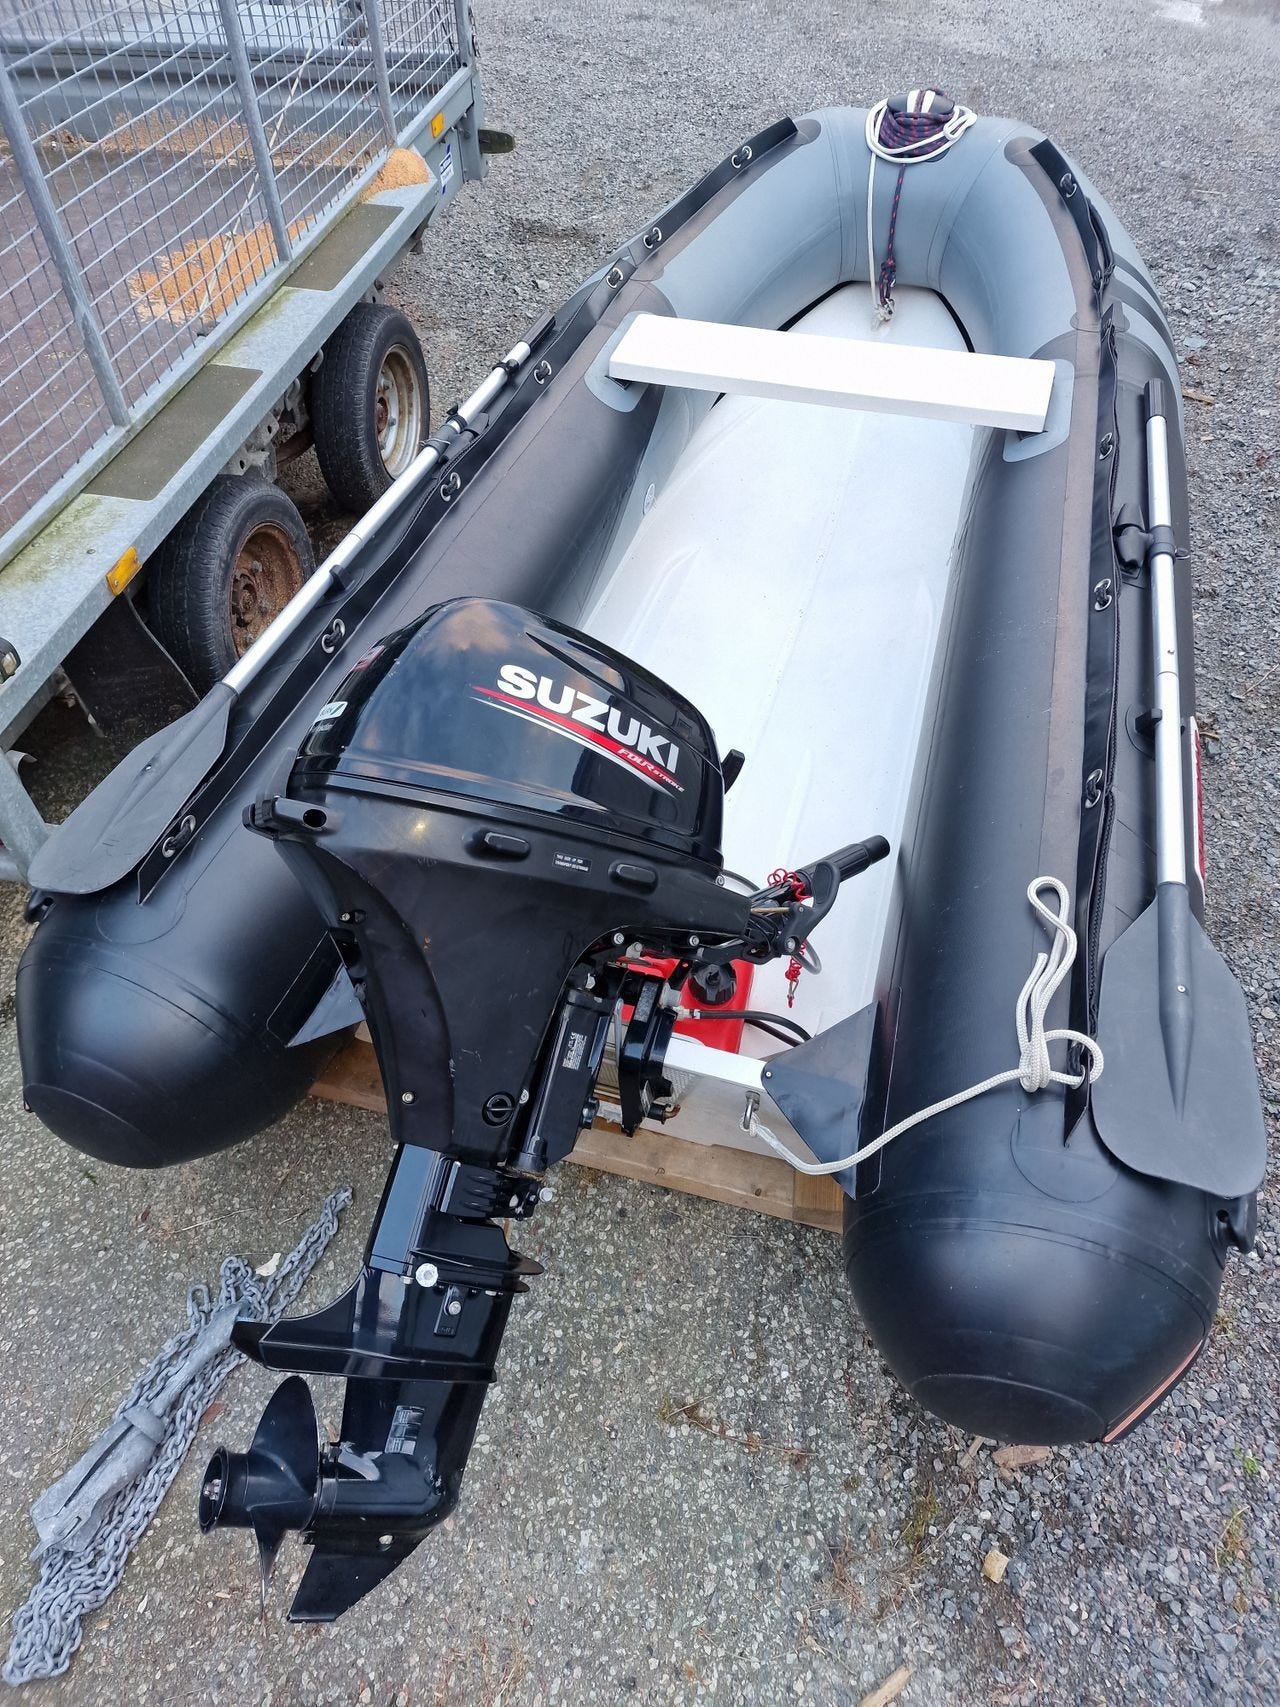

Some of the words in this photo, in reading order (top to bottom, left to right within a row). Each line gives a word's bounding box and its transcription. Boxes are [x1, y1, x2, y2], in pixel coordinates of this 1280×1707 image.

[497, 664, 679, 774] SUZUKI
[617, 748, 655, 772] FOUR
[652, 769, 685, 793] STROKE
